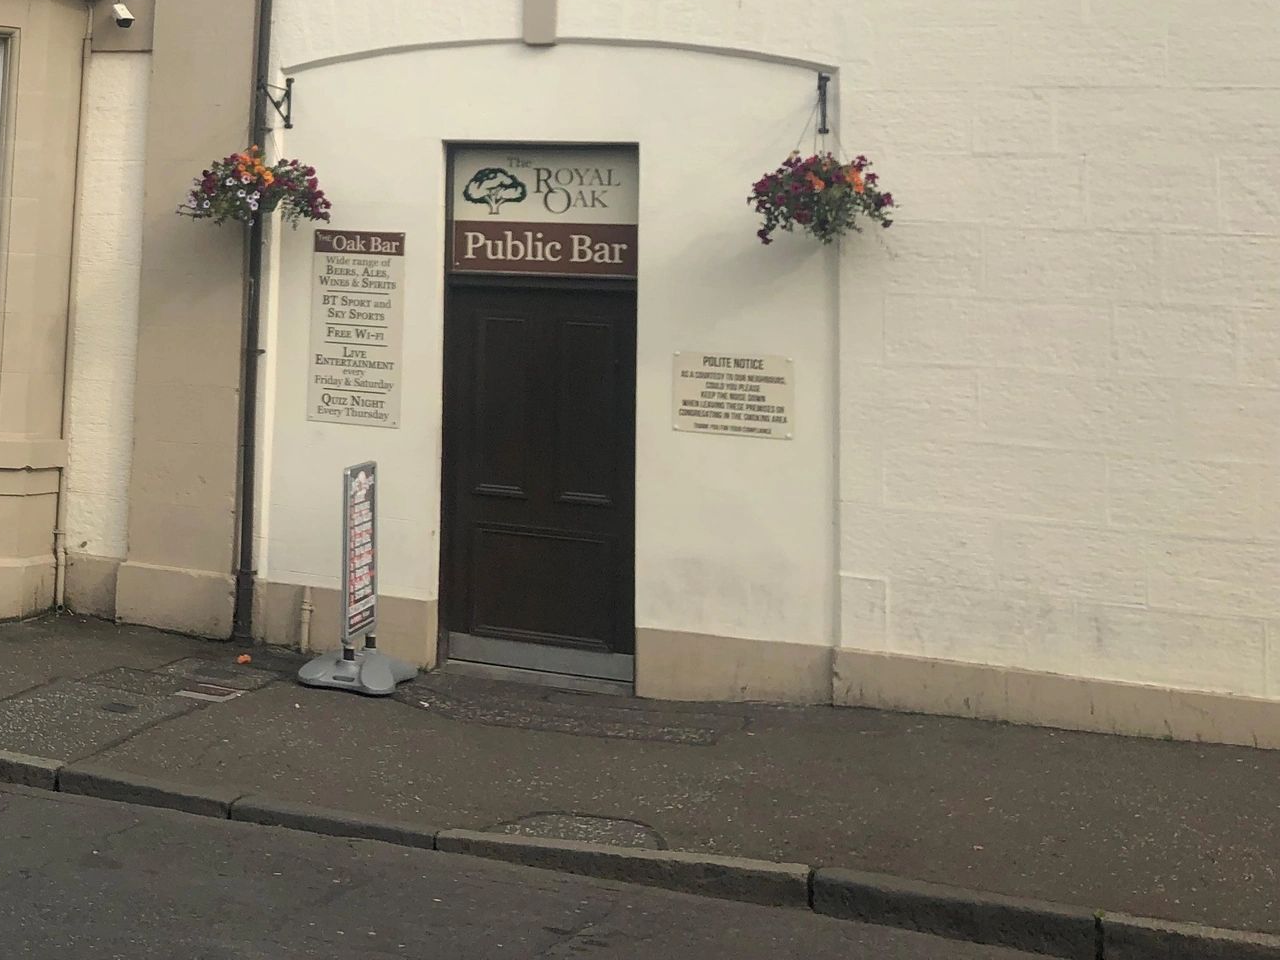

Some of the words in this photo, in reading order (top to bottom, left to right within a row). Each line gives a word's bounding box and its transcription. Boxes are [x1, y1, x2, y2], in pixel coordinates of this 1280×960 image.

[533, 167, 621, 193] ROYAL
[544, 187, 609, 214] OAK
[332, 234, 366, 252] Oak
[370, 236, 400, 253] Bar
[464, 230, 562, 261] Public
[570, 234, 628, 264] Bar
[326, 255, 350, 265] Wide
[352, 258, 378, 269] range
[381, 258, 391, 268] of
[322, 294, 338, 306] BT
[341, 295, 372, 307] SPORT
[373, 299, 391, 309] and
[328, 307, 347, 318] SKY
[349, 308, 385, 321] SPORTS
[327, 326, 352, 338] FREE
[703, 356, 732, 368] POLITE
[733, 358, 765, 370] NOTICE
[314, 374, 343, 387] Friday
[344, 377, 352, 386] &
[353, 377, 394, 391] Saturday
[321, 393, 348, 406] QUIZ
[350, 395, 386, 408] NIGHT
[317, 405, 343, 417] Every
[344, 407, 390, 421] Thursday
